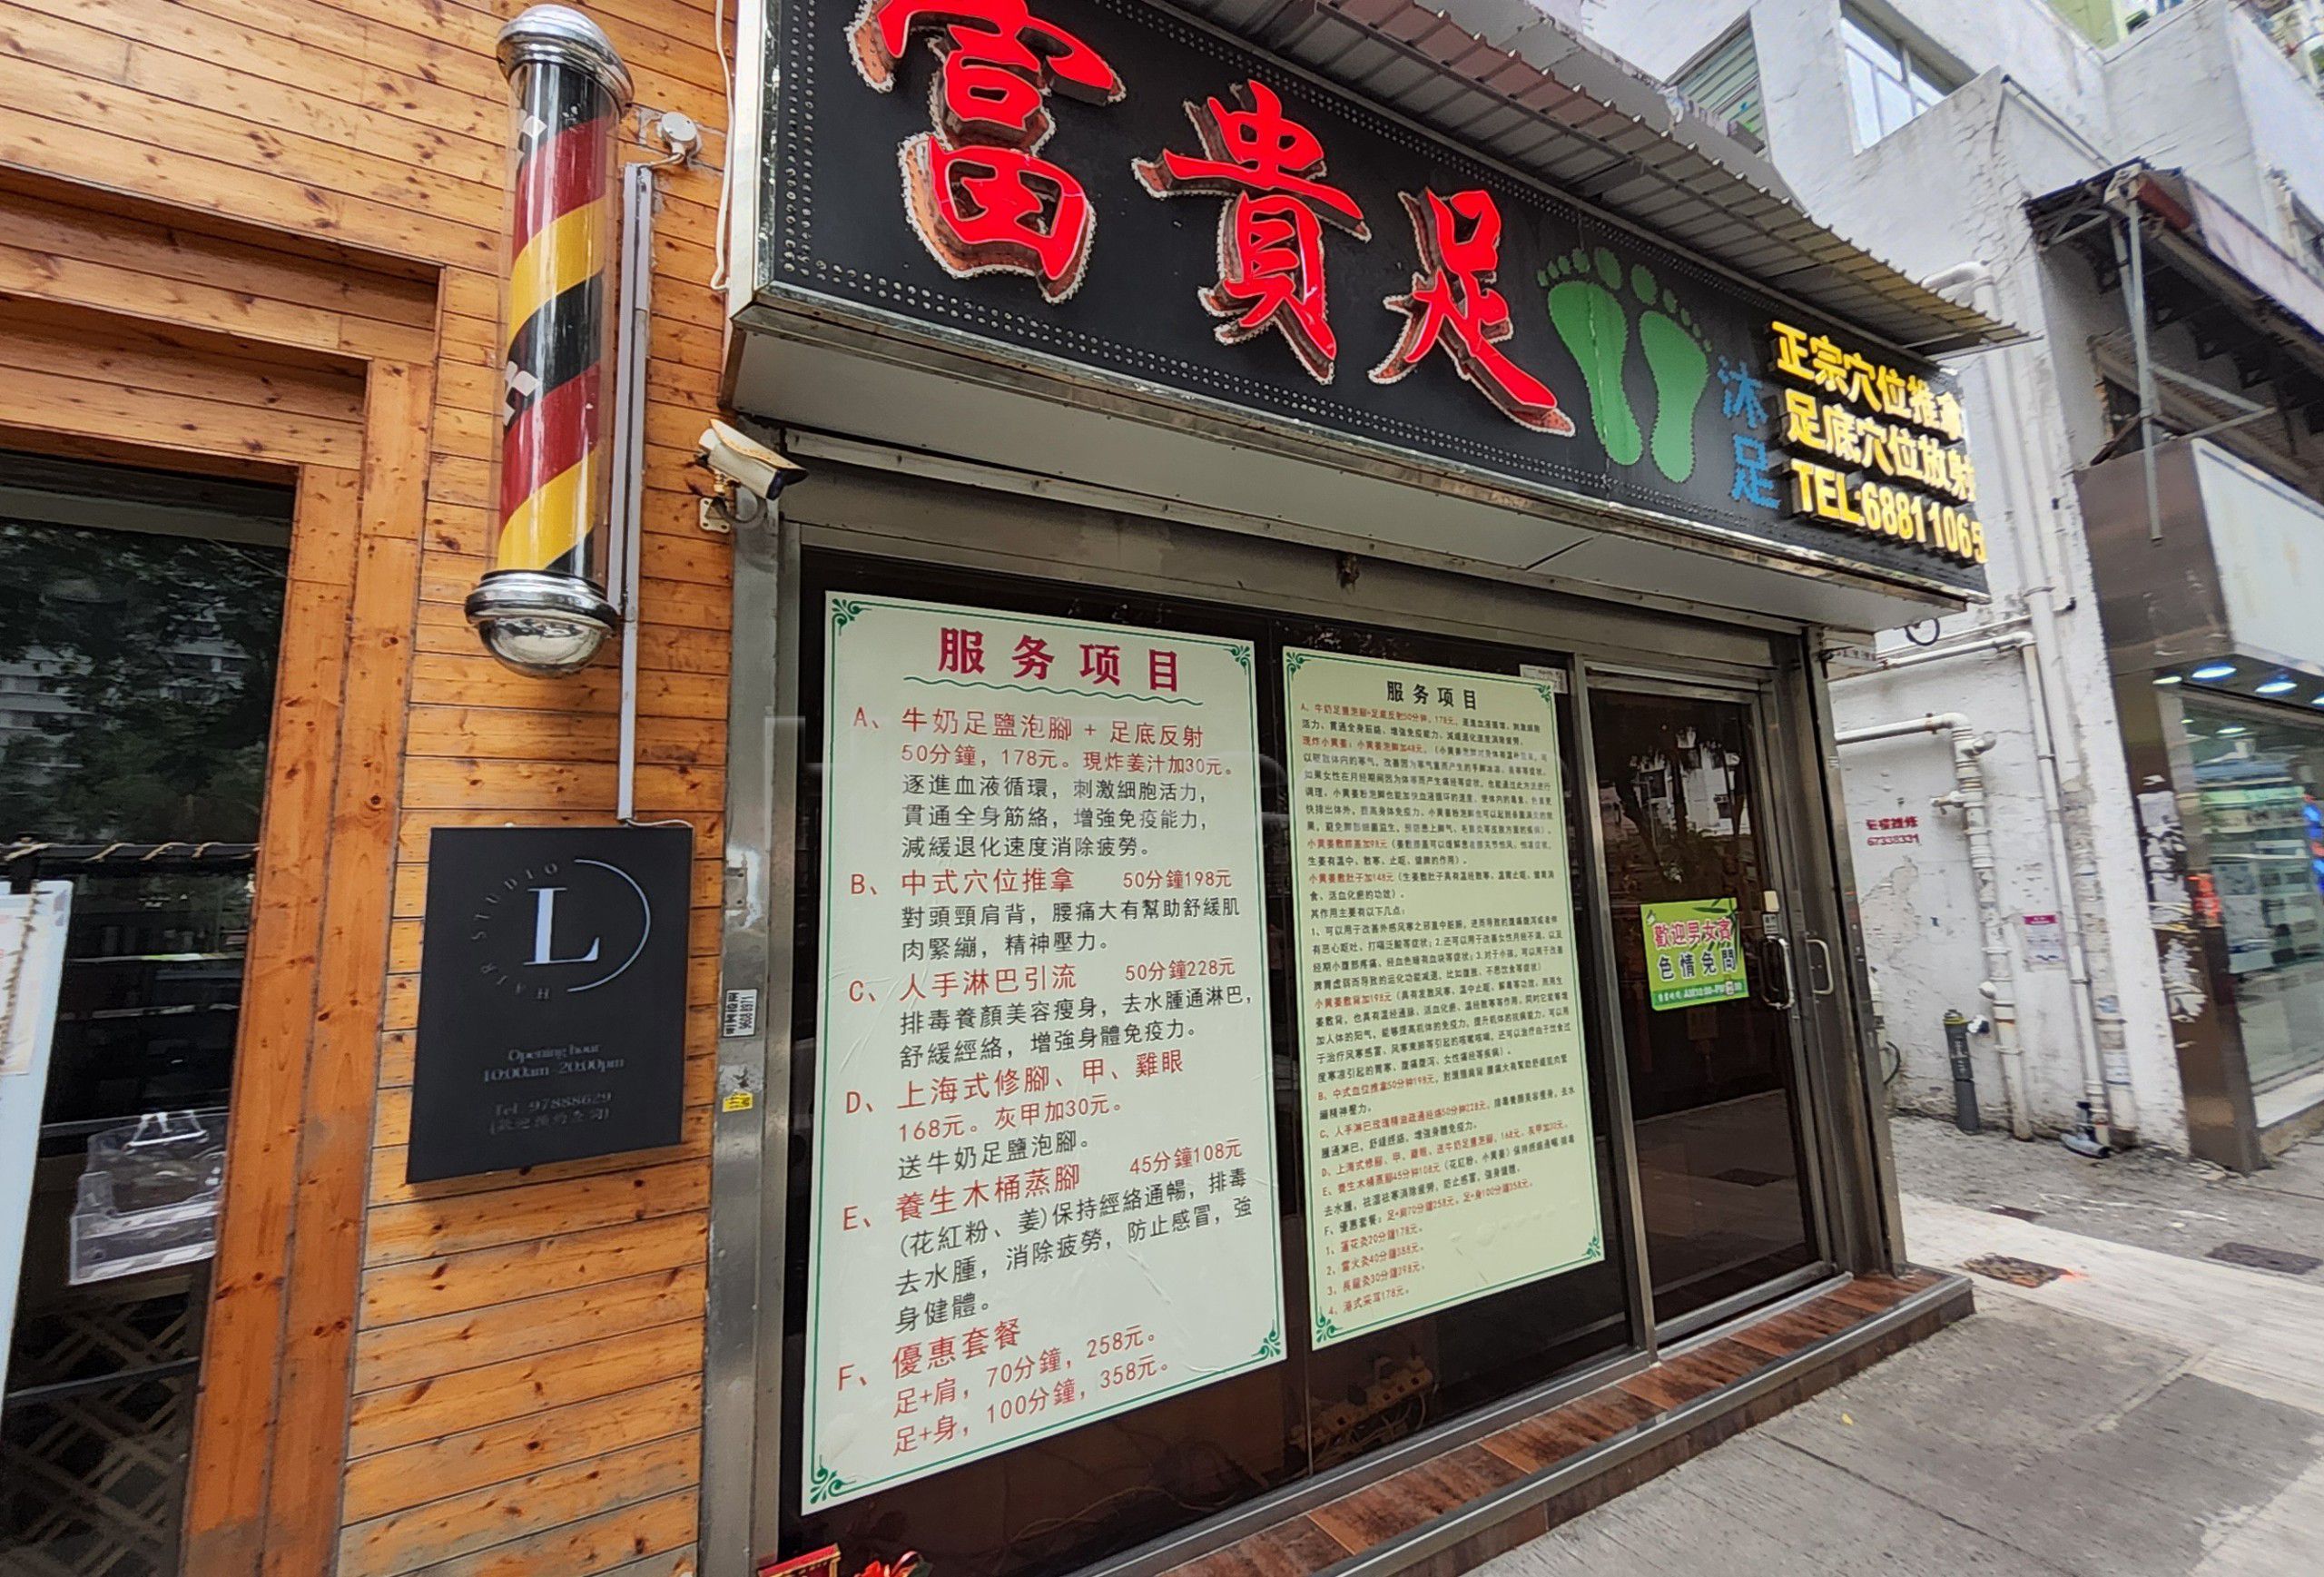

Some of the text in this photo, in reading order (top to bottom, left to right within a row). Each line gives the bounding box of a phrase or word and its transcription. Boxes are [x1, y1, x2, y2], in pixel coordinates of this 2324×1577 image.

[848, 0, 1575, 434] 富貴足
[938, 626, 1178, 692] 服务项目
[1385, 678, 1477, 711] 服务项目
[900, 868, 1075, 897] 中式穴位推拿
[1122, 868, 1232, 890] 50分鐘198元
[522, 886, 600, 966] L
[899, 963, 1077, 1002] 人手淋巴引流
[1124, 955, 1236, 983] 50分鐘228元
[1658, 948, 1738, 981] 色情免問
[893, 1162, 1080, 1224] 養生木桶蒸腳
[1128, 1137, 1243, 1178] 45分鐘108元
[894, 1286, 991, 1336] 身健體。
[891, 1316, 1020, 1381] 優惠套餐
